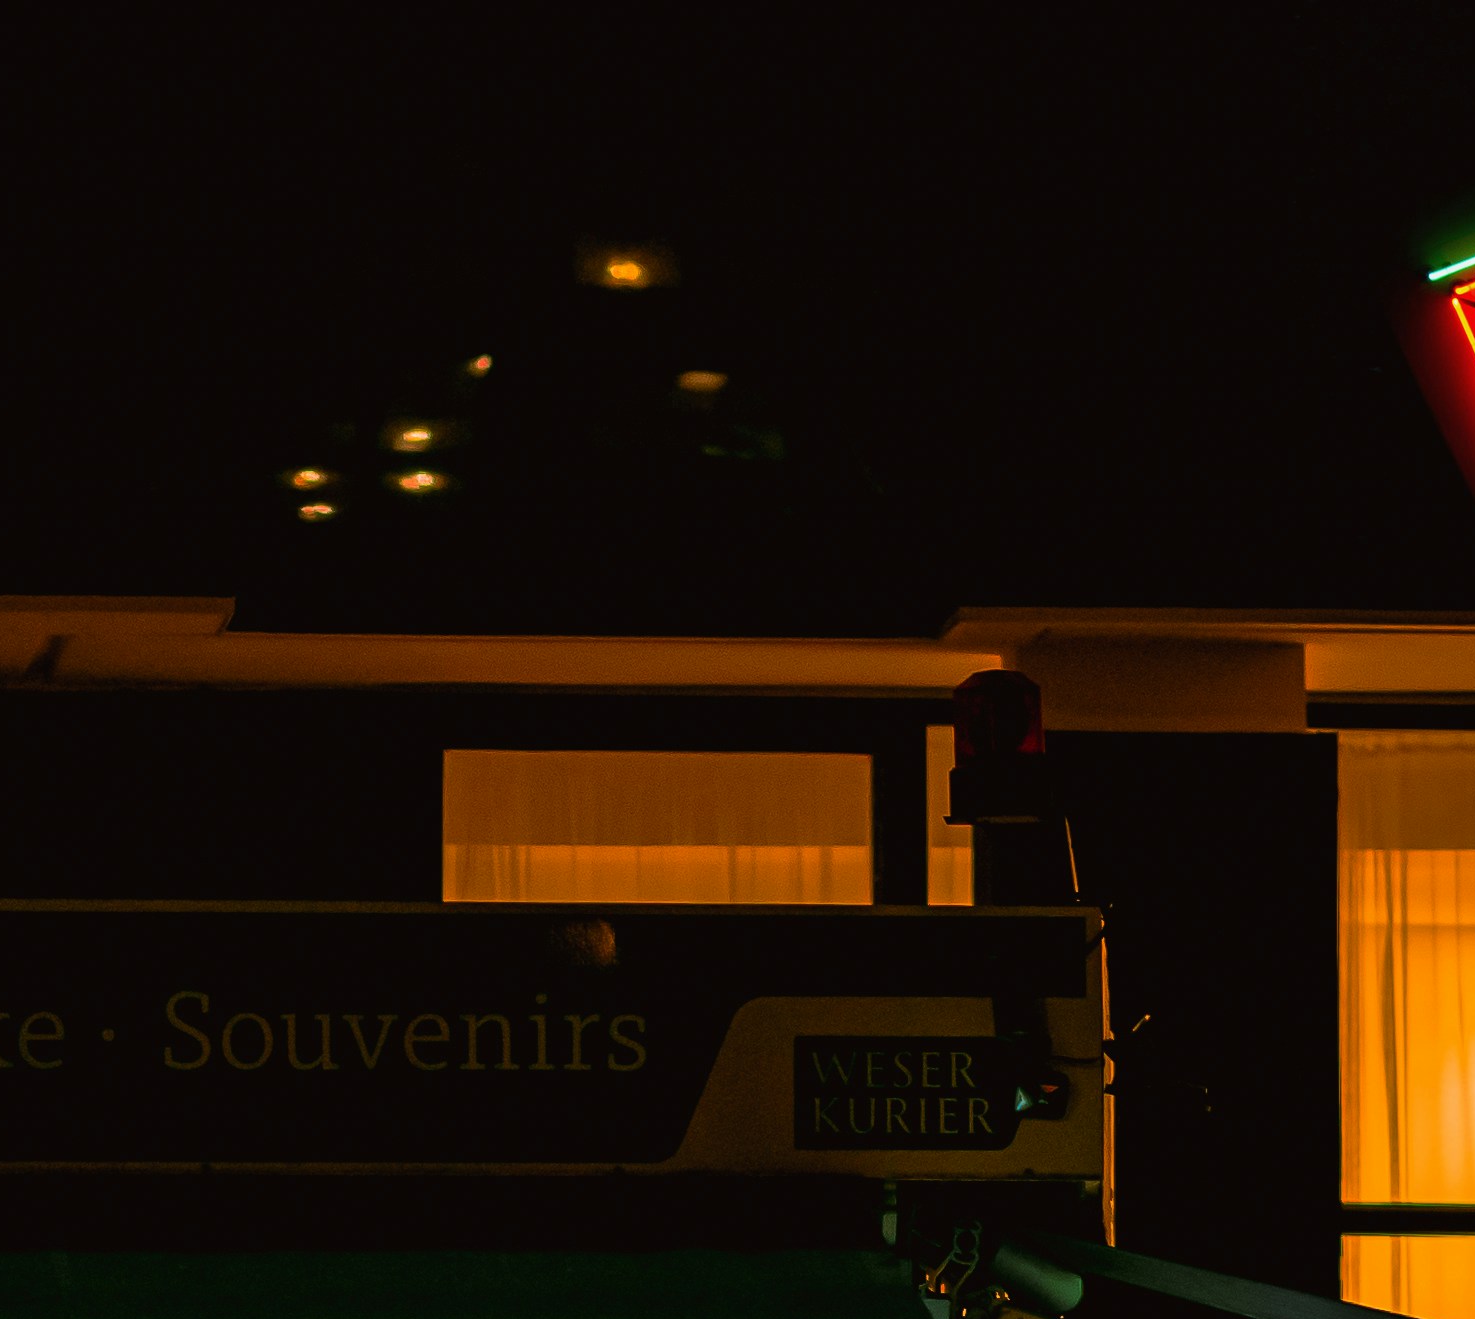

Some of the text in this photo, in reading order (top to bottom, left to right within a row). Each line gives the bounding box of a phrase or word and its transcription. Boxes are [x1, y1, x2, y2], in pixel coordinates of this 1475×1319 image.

[163, 990, 650, 1073] Souvenirs
[810, 1050, 977, 1090] WESER
[812, 1096, 996, 1135] KURIER
